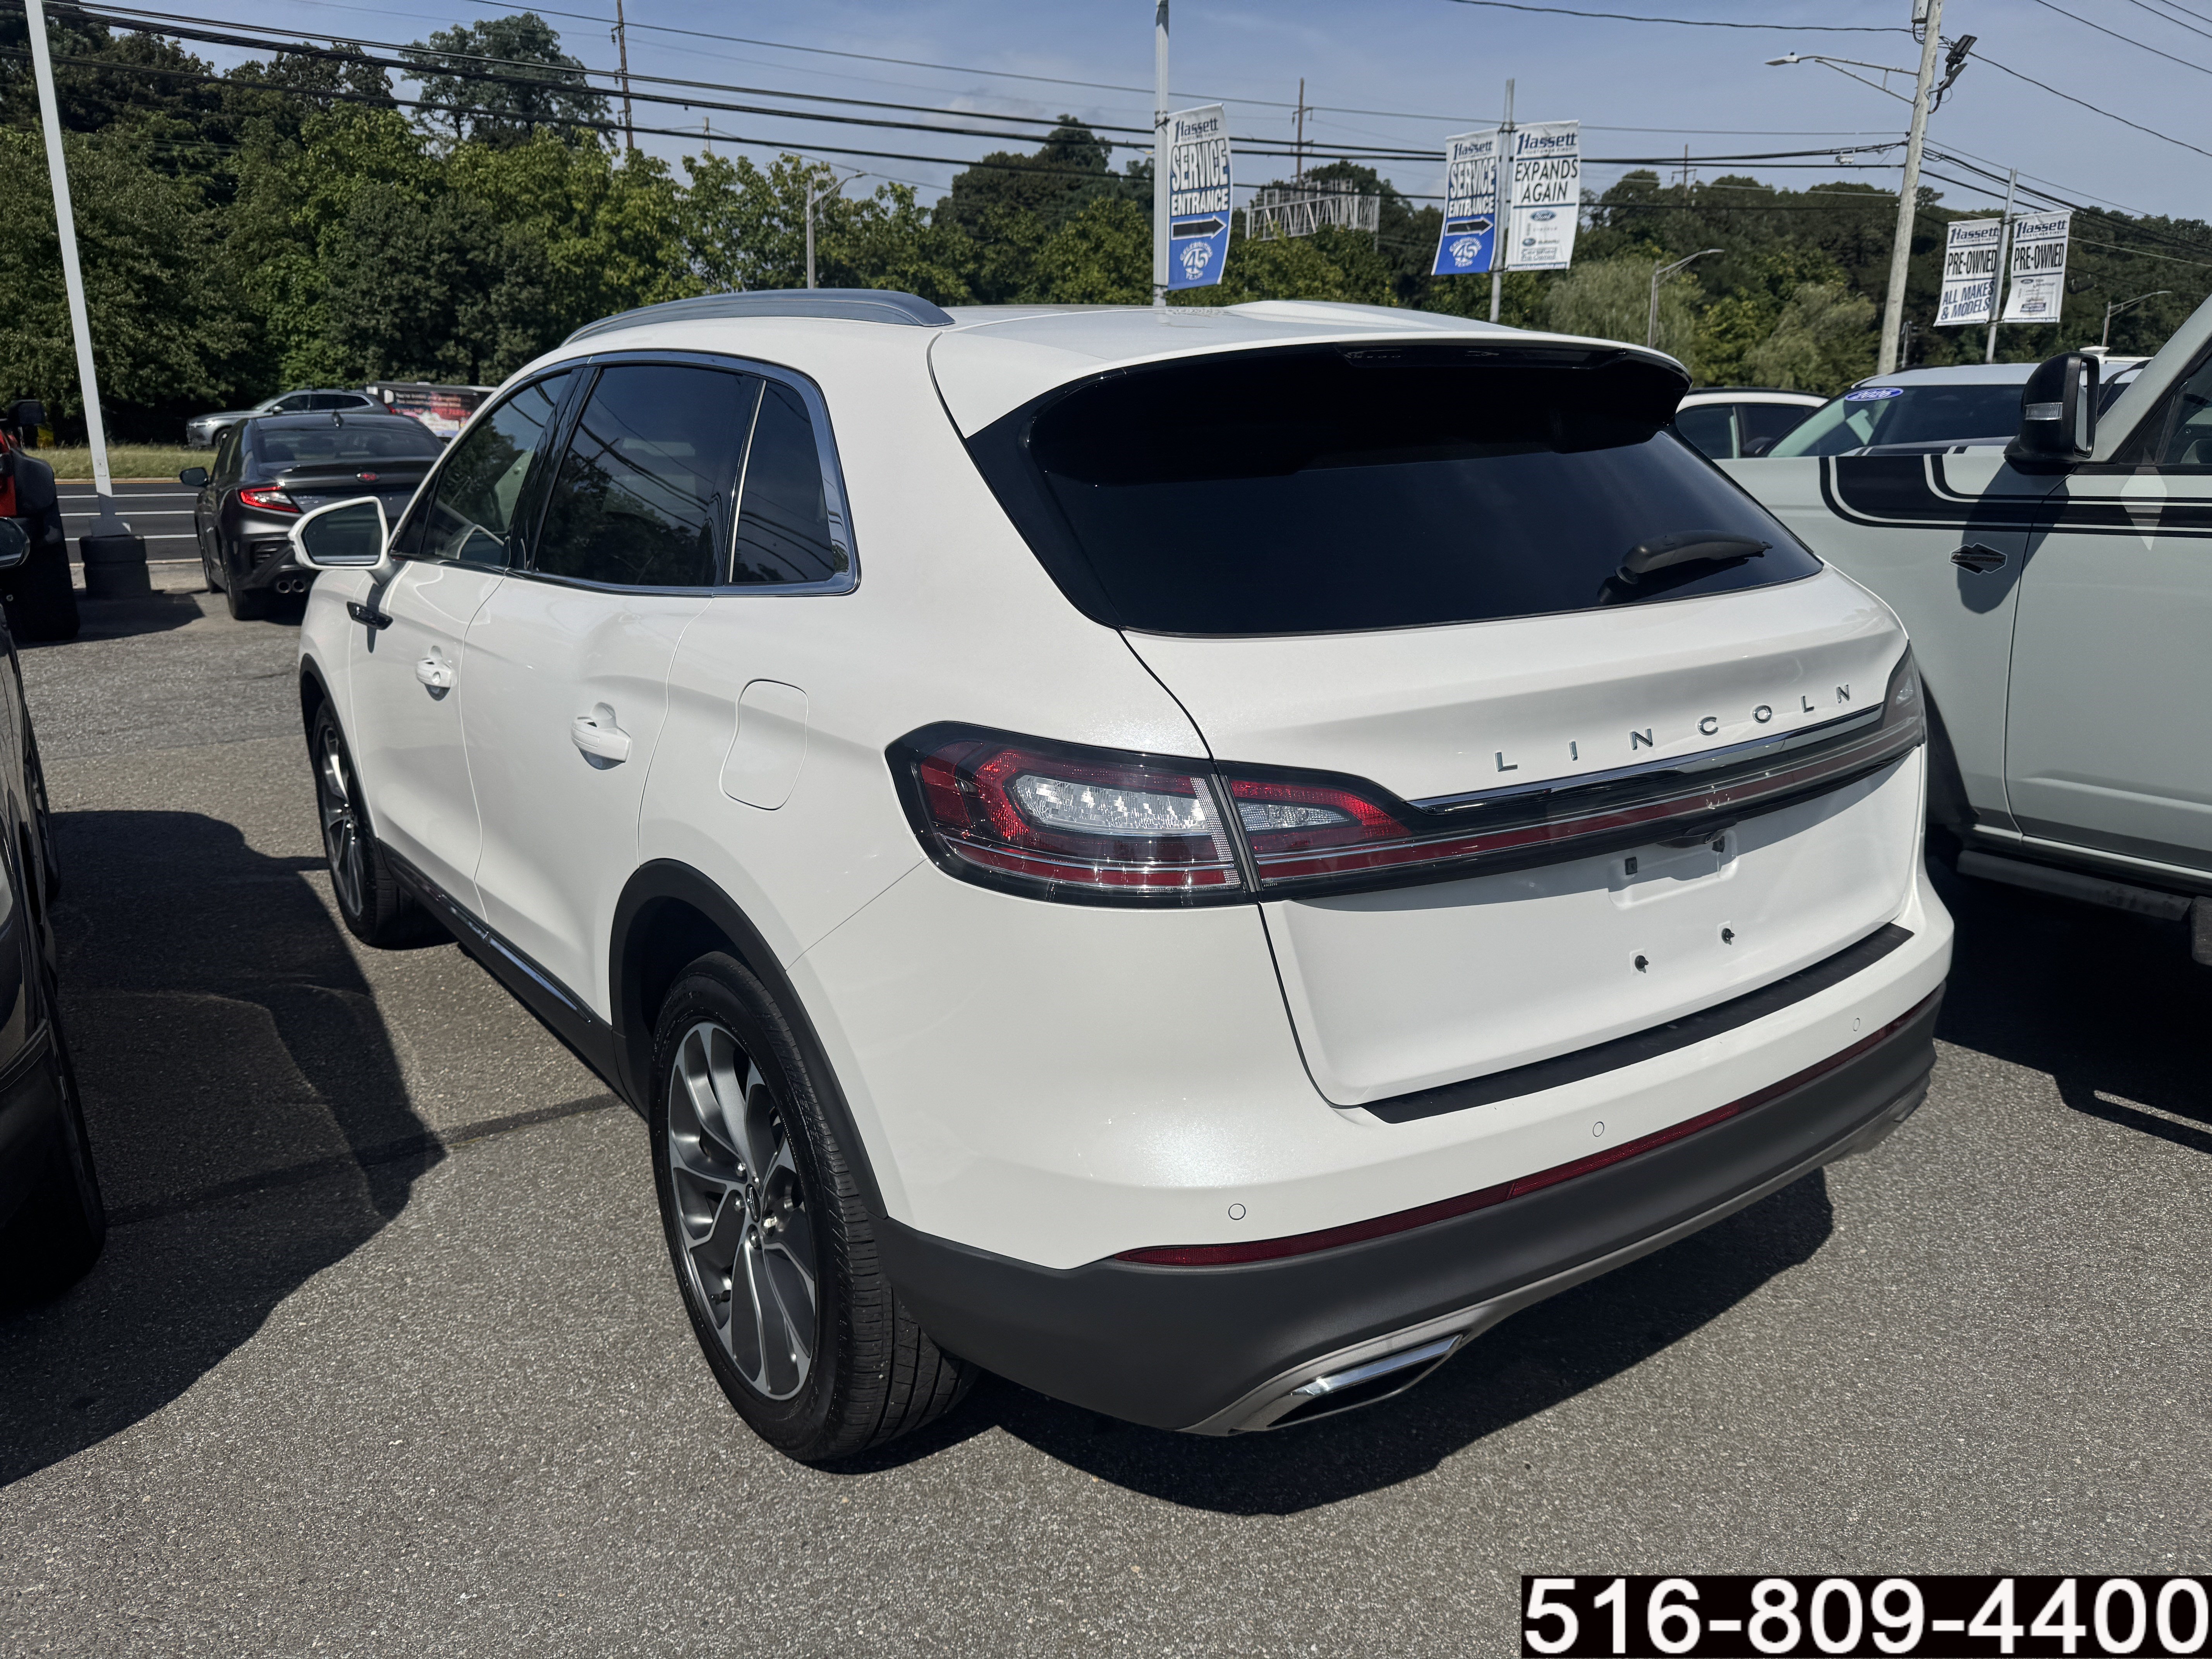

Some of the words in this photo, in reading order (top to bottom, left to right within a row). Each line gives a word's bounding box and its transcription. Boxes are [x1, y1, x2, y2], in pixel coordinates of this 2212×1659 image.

[1517, 133, 1578, 155] Hassett
[1171, 139, 1228, 192] SERVICE
[1515, 159, 1578, 182] EXPANDS
[1449, 156, 1496, 199] SERVICE
[1171, 189, 1228, 216] ENTRANCE
[1521, 181, 1568, 203] AGAIN
[1448, 196, 1495, 218] ENTRANCE
[1949, 227, 1999, 244] Hassett
[2016, 220, 2068, 238] Hassett
[1184, 248, 1209, 273] 45
[1453, 242, 1478, 263] 45
[1946, 249, 1997, 276] PRE-OWNED
[2014, 243, 2064, 271] PRE-OWNED
[1942, 290, 1958, 305] ALL
[1961, 281, 1994, 301] MAKES
[1941, 307, 1949, 319] &
[1951, 297, 1991, 319] MODELS
[1495, 683, 1850, 772] LINCOLN
